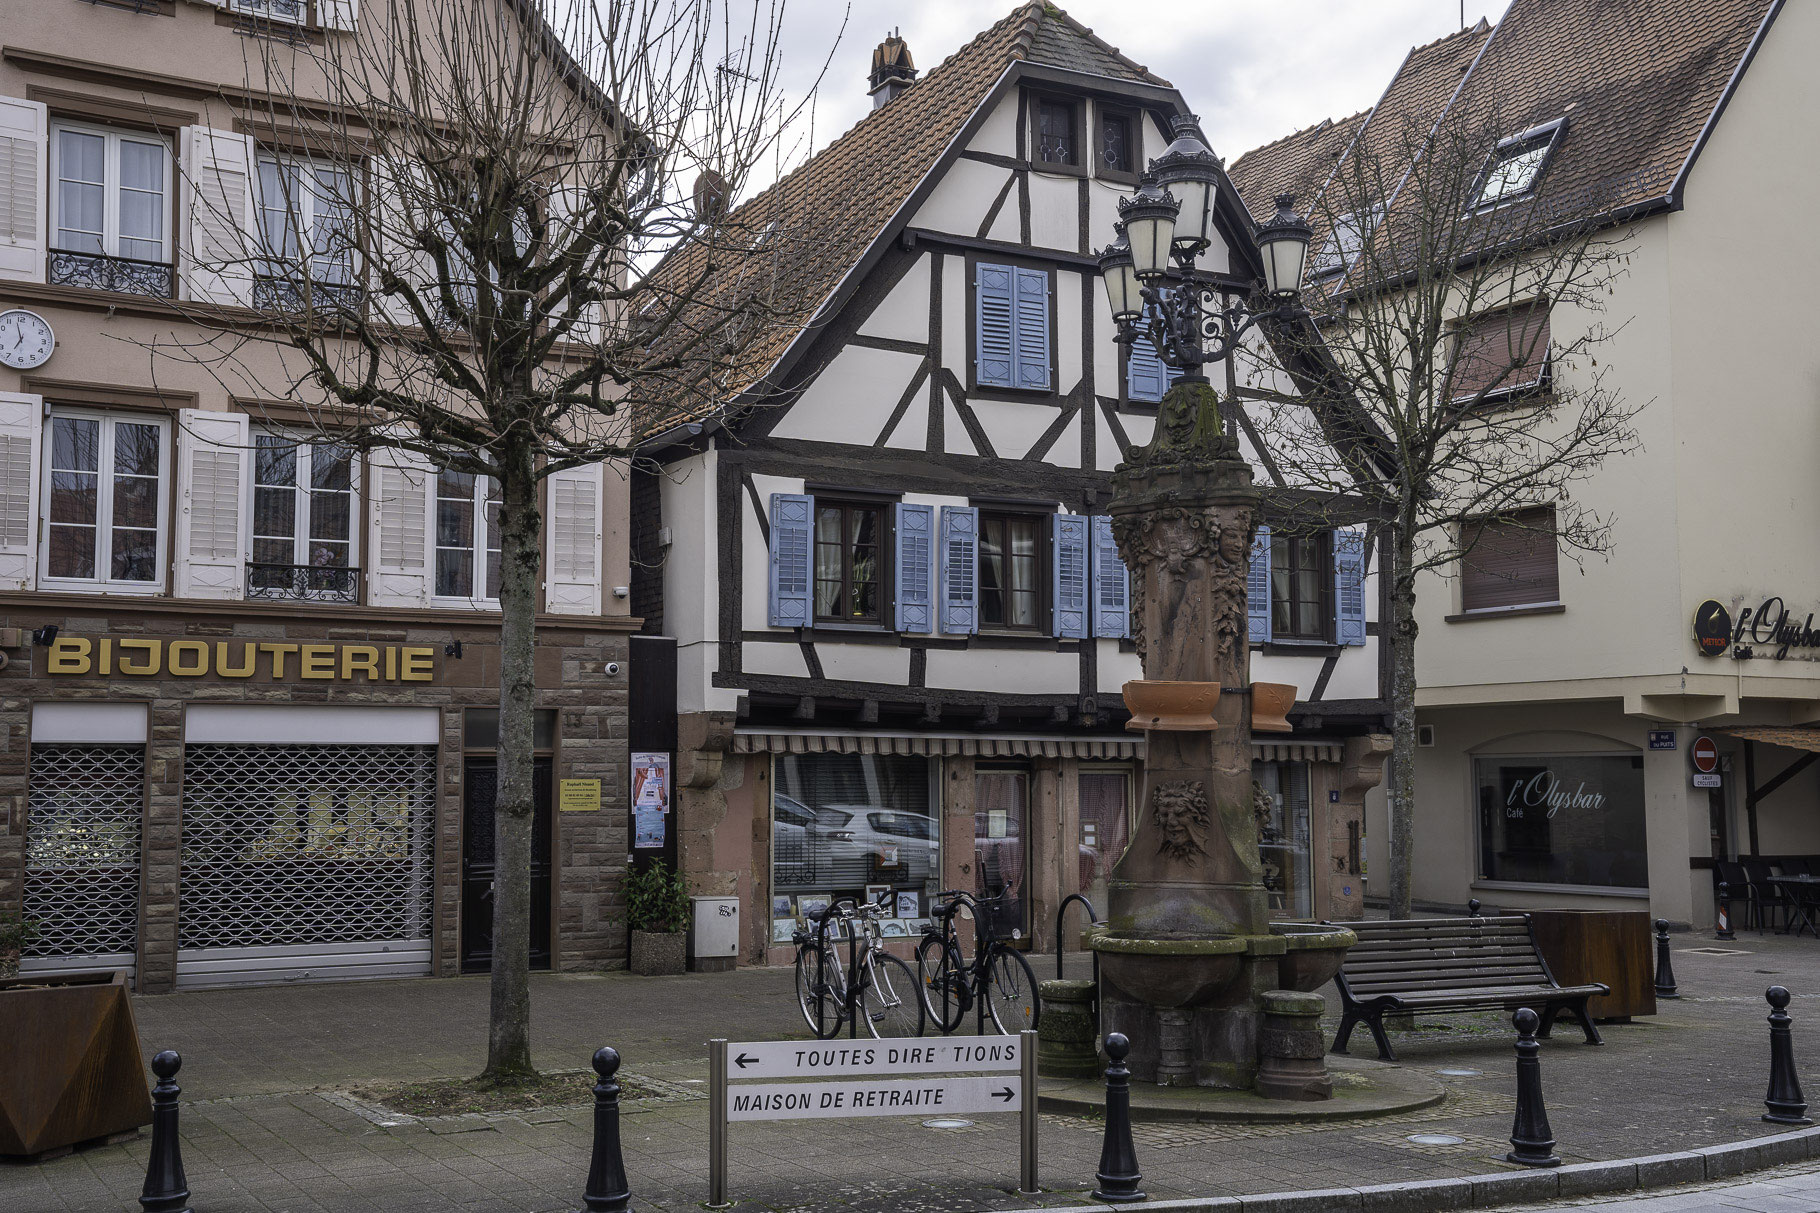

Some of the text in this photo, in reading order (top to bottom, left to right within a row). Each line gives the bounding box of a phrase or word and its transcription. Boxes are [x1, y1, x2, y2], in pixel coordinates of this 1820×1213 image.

[1702, 638, 1726, 646] METEOR
[48, 637, 434, 682] BIJOUTERIE
[1506, 807, 1524, 818] Café
[795, 1044, 1016, 1067] TOUTES DIRETIONS
[733, 1088, 944, 1112] MAISON DE RETRAITE
